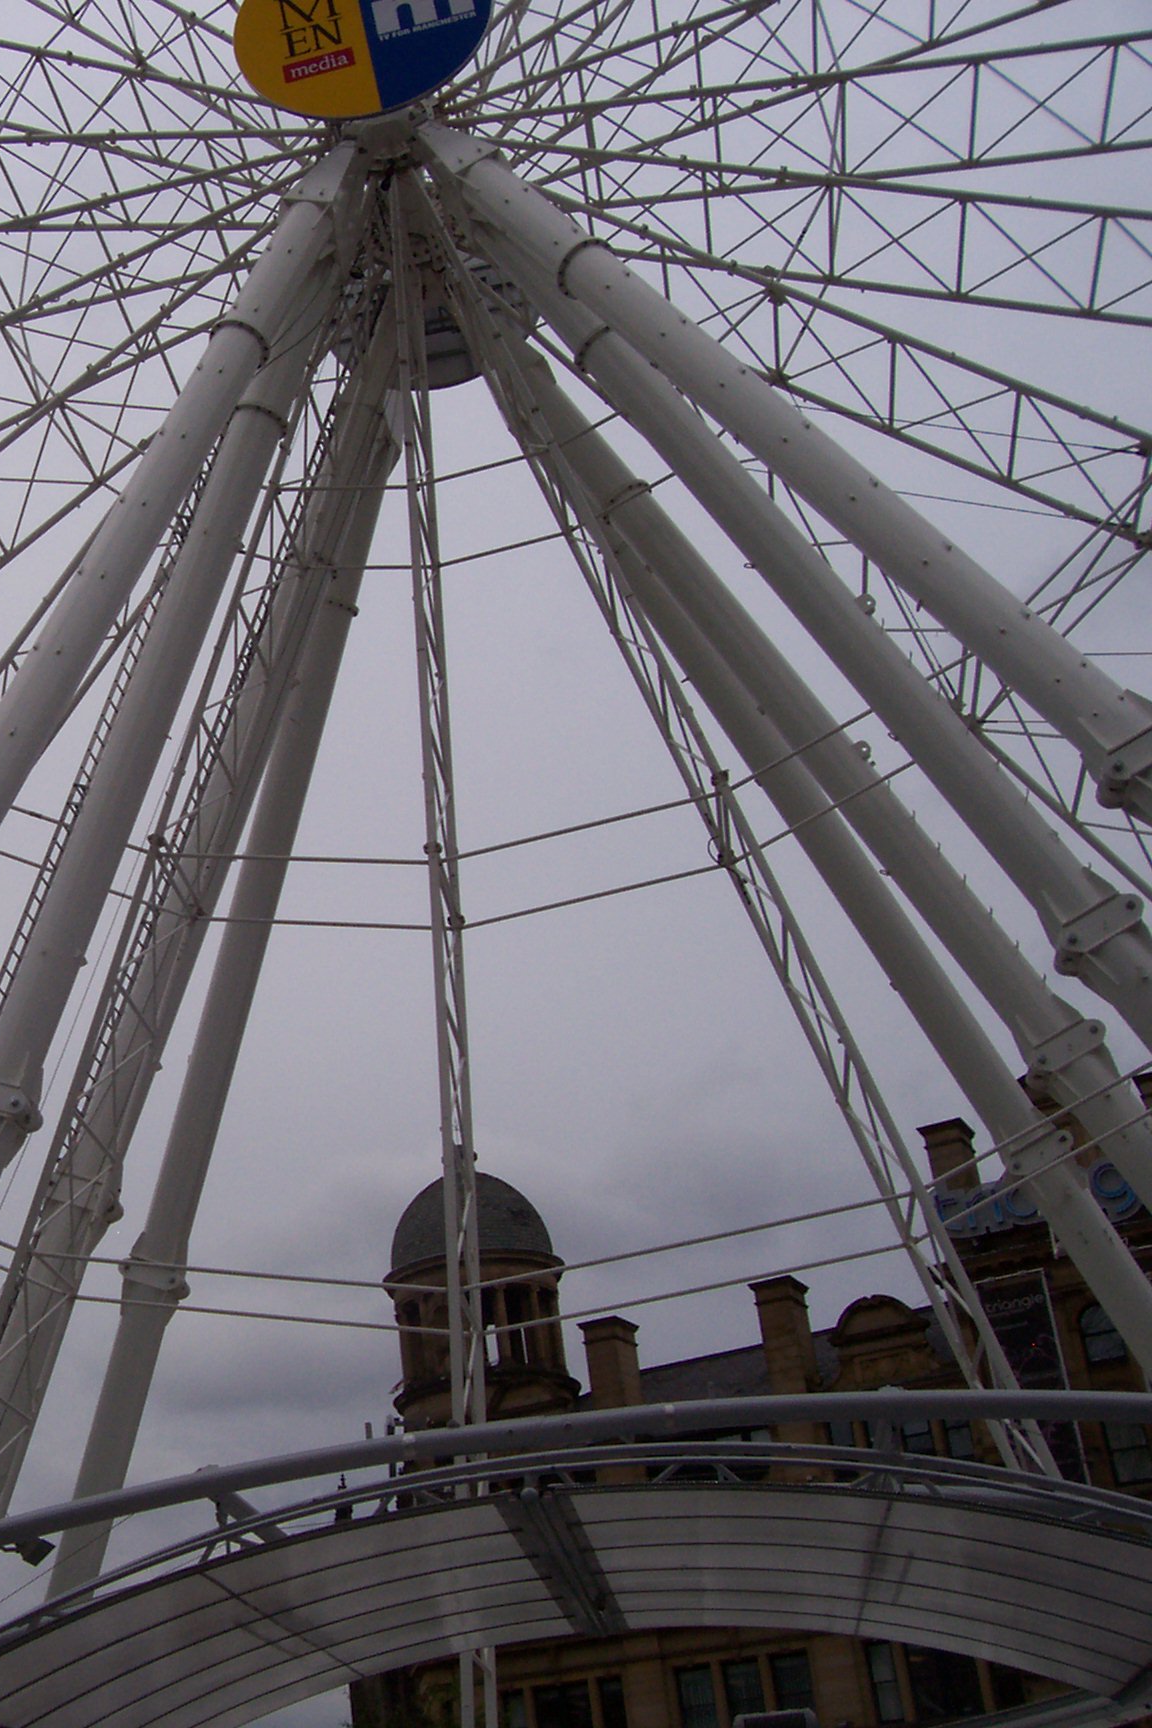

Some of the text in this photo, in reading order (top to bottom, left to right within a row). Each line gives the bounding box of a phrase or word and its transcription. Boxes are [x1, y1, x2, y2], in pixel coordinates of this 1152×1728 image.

[274, 0, 341, 31] M
[412, 10, 477, 32] MANCHESTER
[281, 19, 341, 59] EN
[290, 54, 349, 78] media
